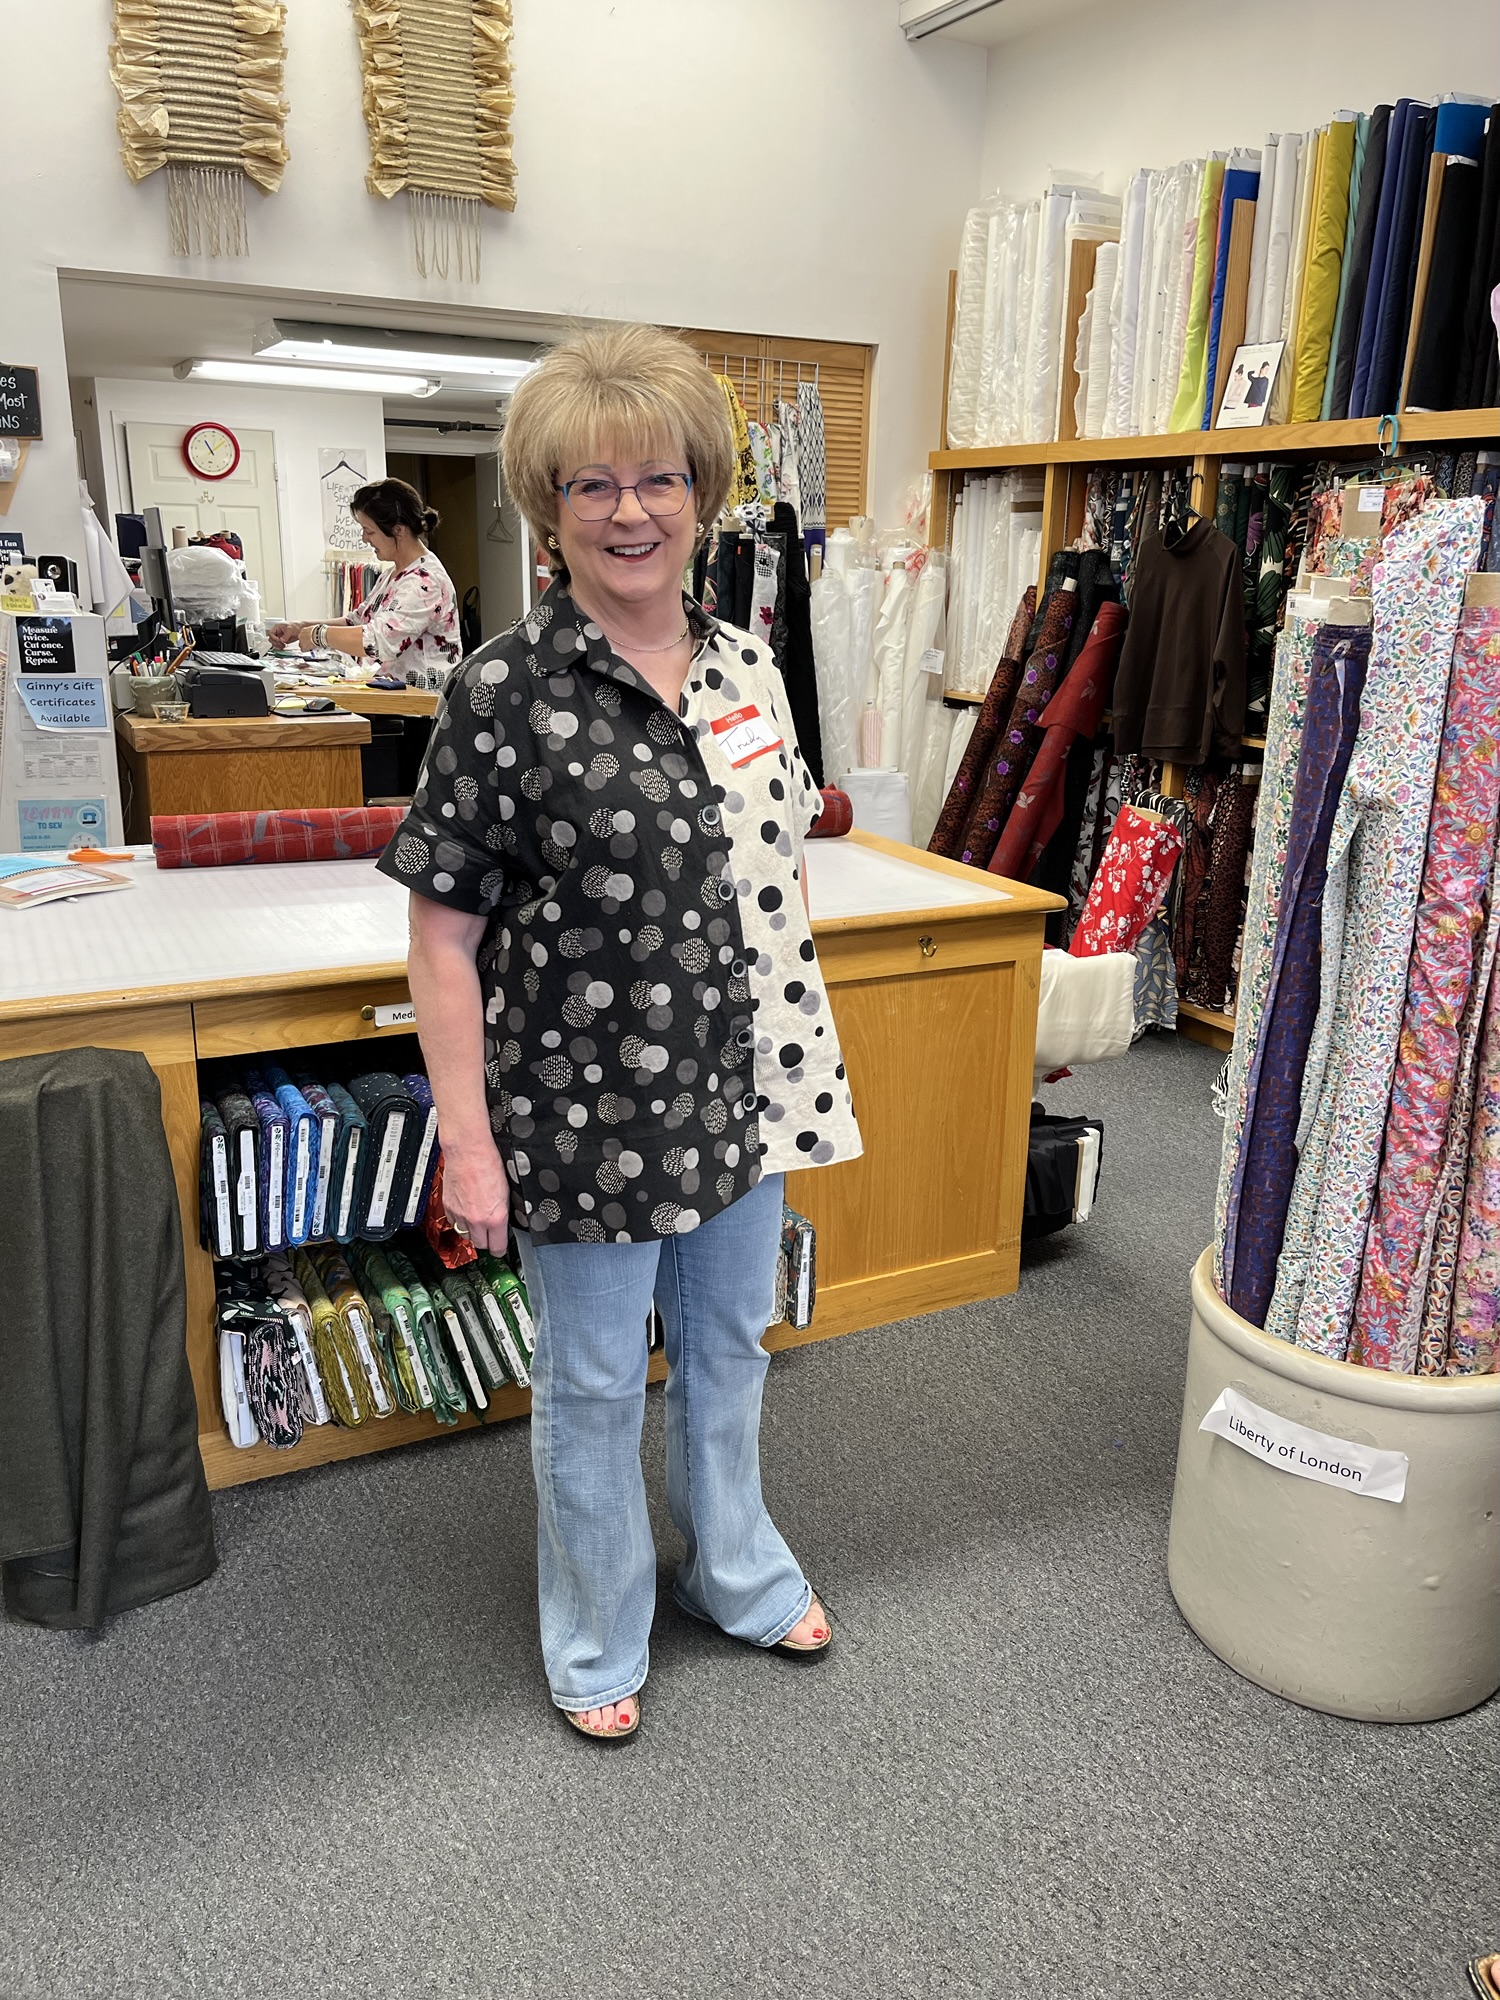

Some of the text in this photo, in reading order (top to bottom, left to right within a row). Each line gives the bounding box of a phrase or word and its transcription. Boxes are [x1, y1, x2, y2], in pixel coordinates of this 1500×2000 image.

[326, 482, 344, 493] LIFE
[22, 626, 58, 635] Measure
[24, 641, 39, 649] Cut
[25, 656, 58, 666] Repeat.
[26, 681, 95, 692] Ginny's Gift
[30, 698, 96, 707] Certificates
[40, 714, 91, 723] Available
[725, 712, 743, 724] Hello
[719, 726, 769, 755] Trudy
[392, 1010, 416, 1020] Medi
[1229, 1415, 1363, 1482] Liberty of London
